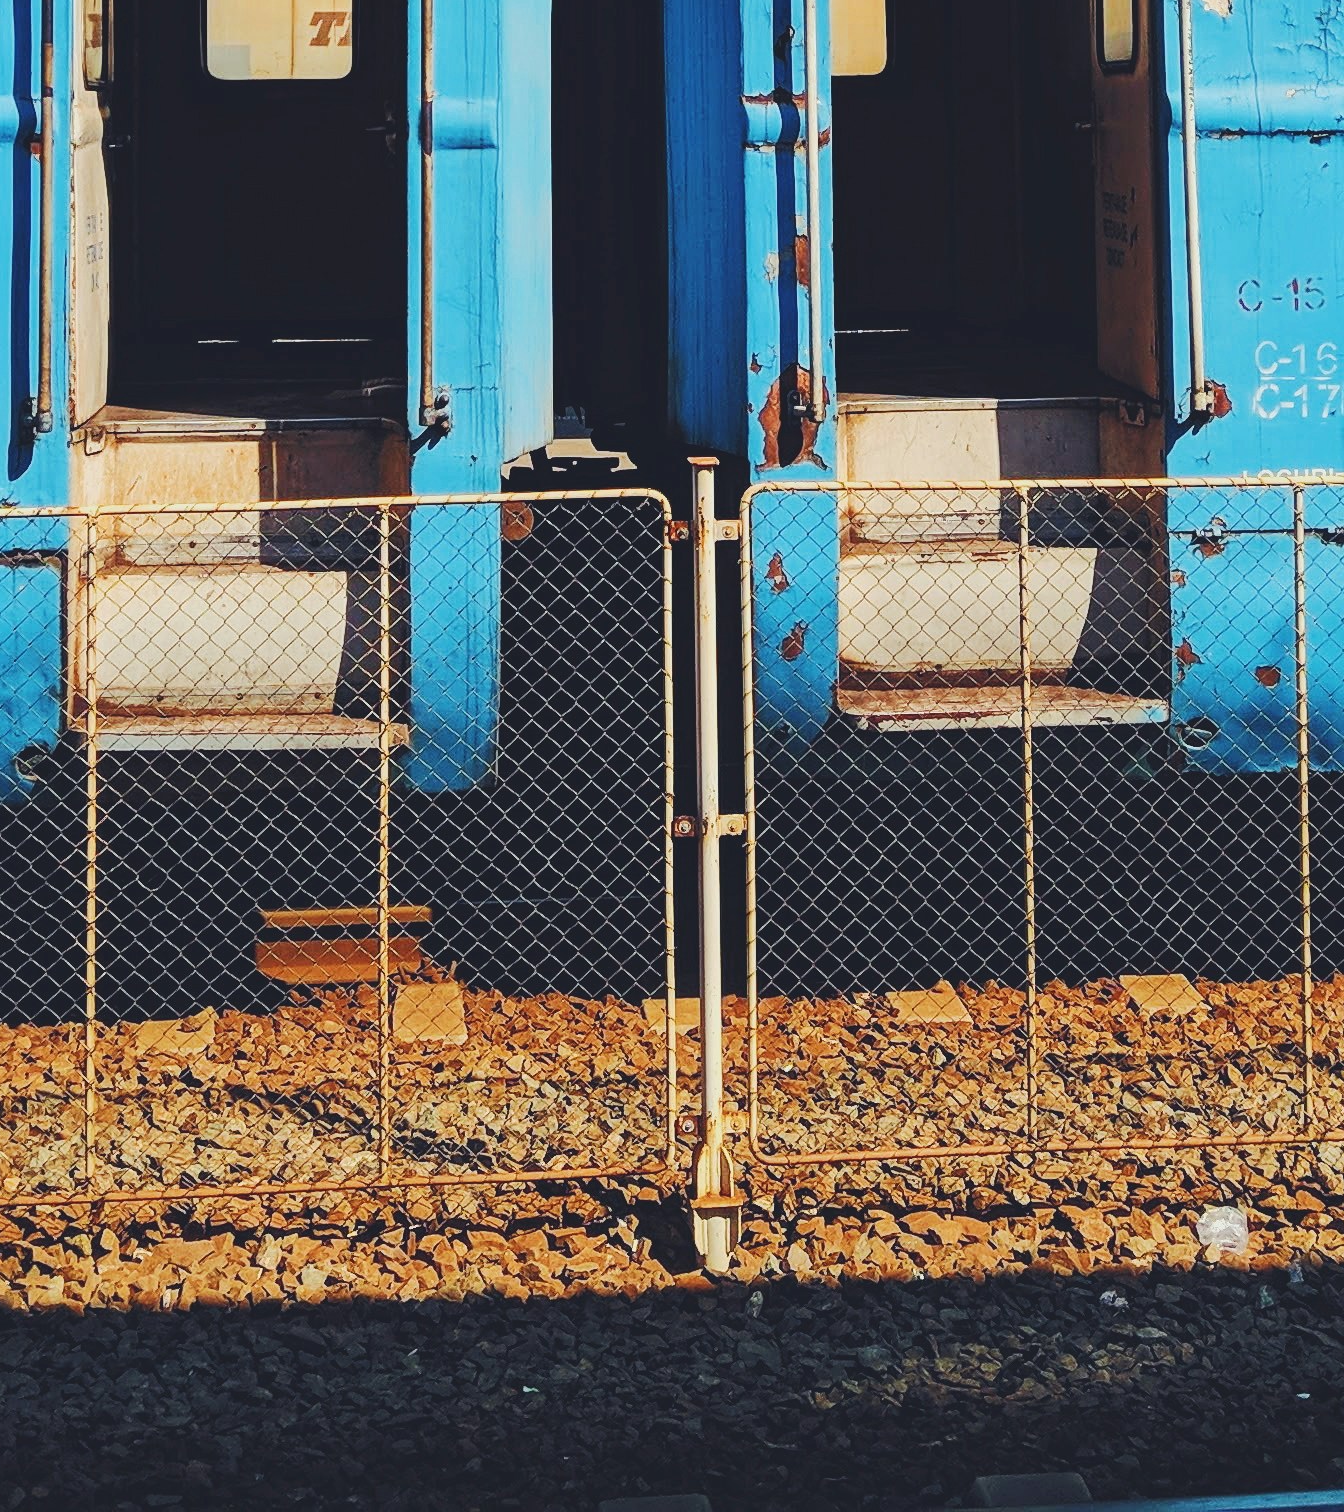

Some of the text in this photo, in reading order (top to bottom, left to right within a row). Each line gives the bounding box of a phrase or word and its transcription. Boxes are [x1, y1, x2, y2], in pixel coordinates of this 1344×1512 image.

[1238, 277, 1326, 312] C-15
[1255, 340, 1339, 376] C-16
[1255, 383, 1342, 420] C-17
